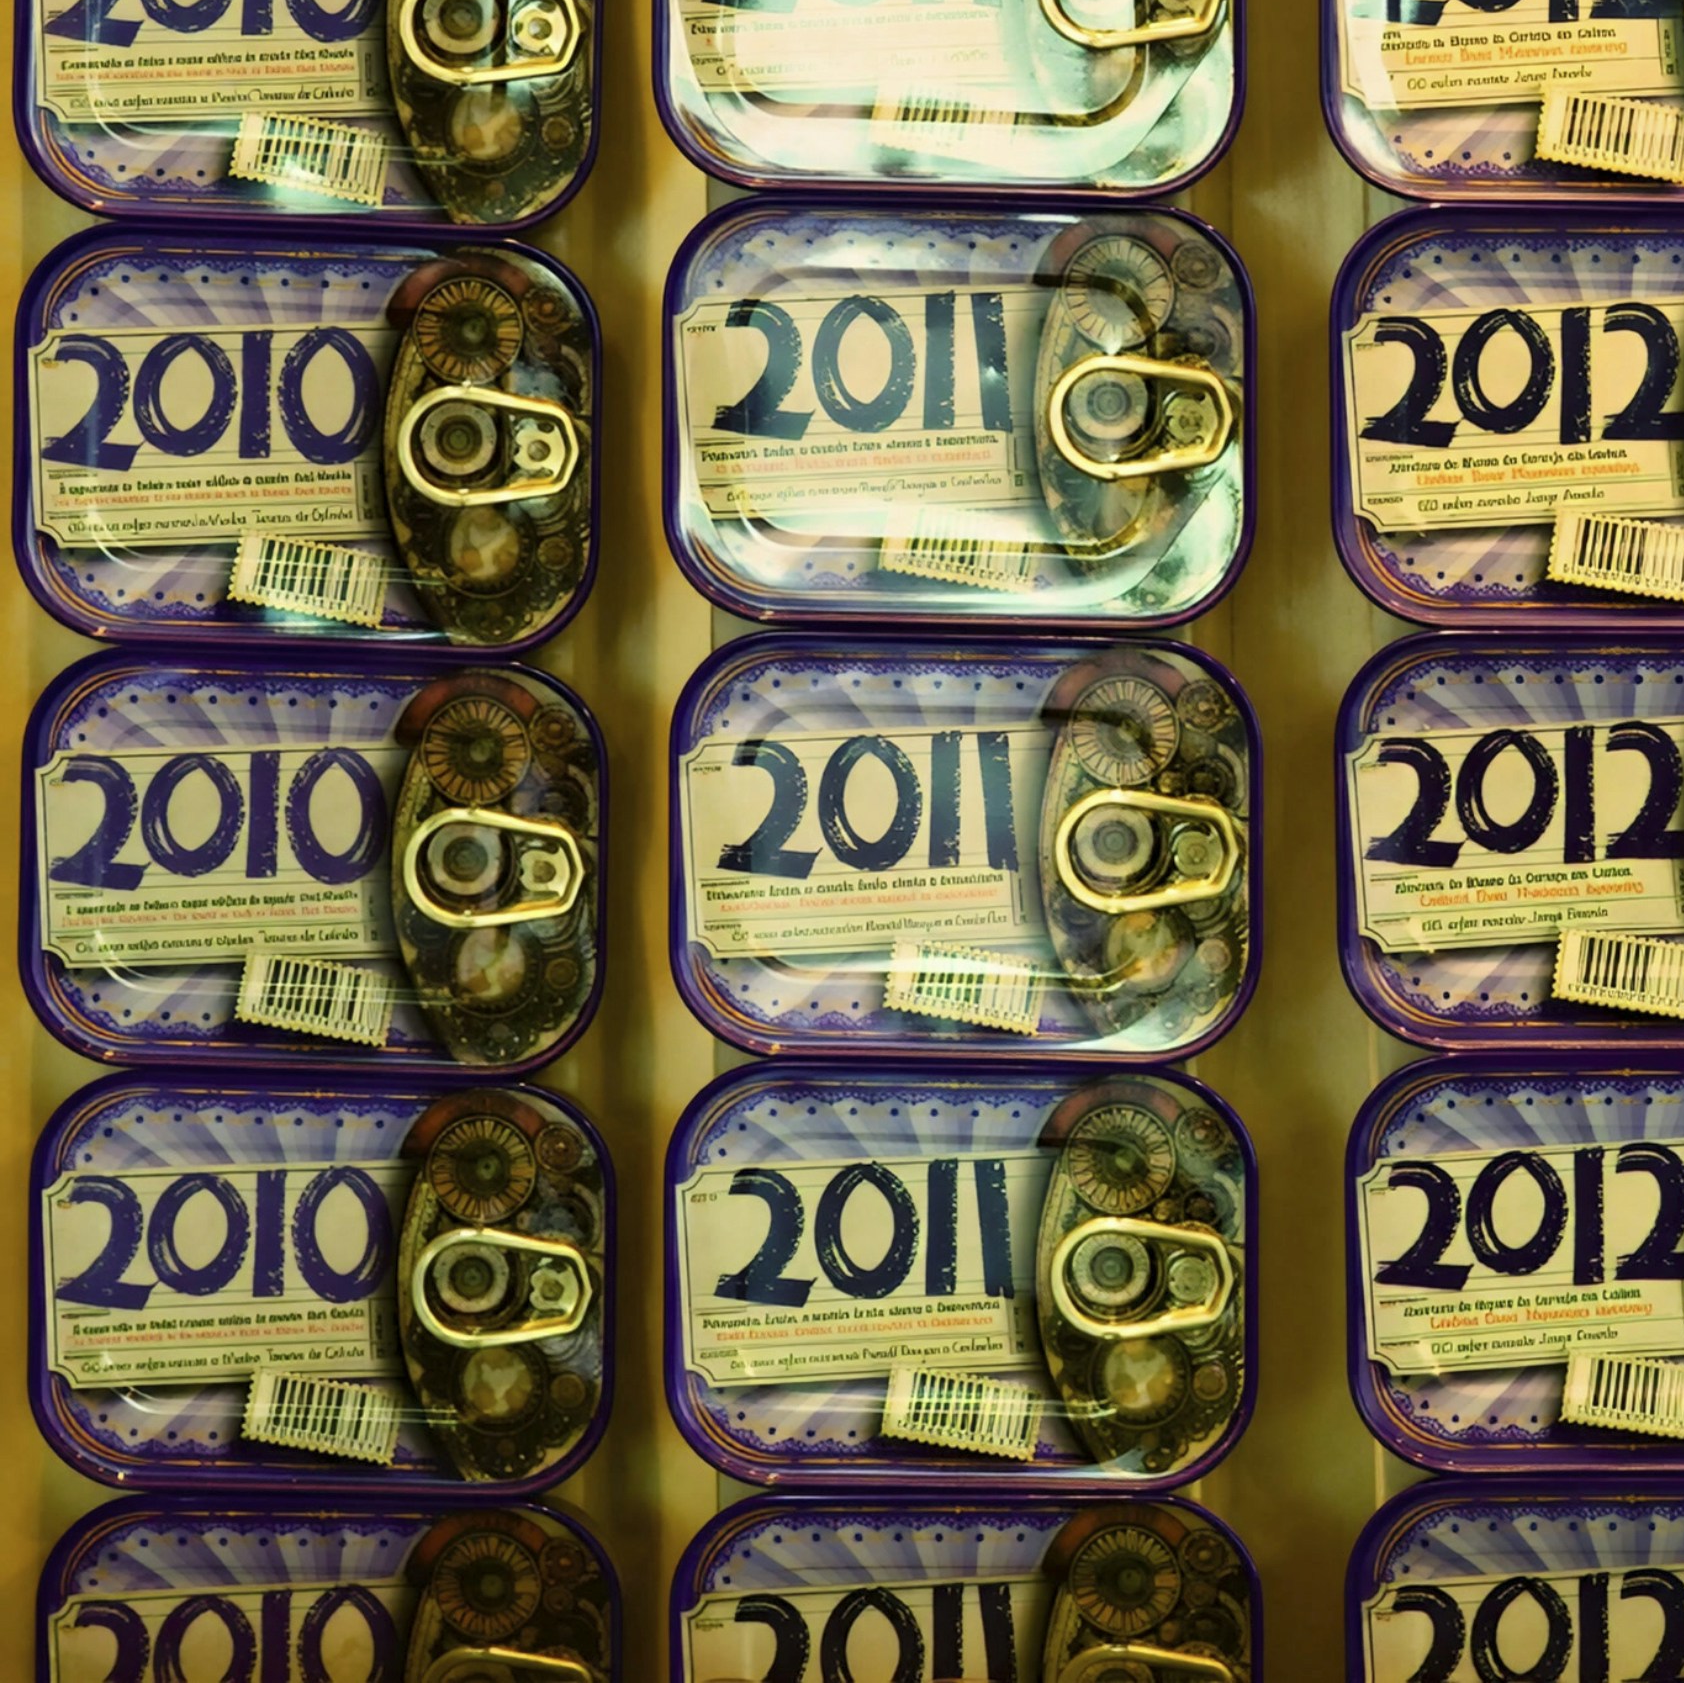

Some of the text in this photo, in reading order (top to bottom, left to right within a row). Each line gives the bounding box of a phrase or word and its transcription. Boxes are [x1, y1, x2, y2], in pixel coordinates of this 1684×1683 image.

[44, 326, 381, 470] 2010
[713, 293, 1014, 438] 2011
[50, 748, 390, 891] 2010
[719, 730, 1020, 879] 2011
[55, 1166, 395, 1311] 2010
[714, 1159, 1016, 1306] 2011
[68, 1586, 402, 1683] 2010
[735, 1586, 1019, 1683] 2011
